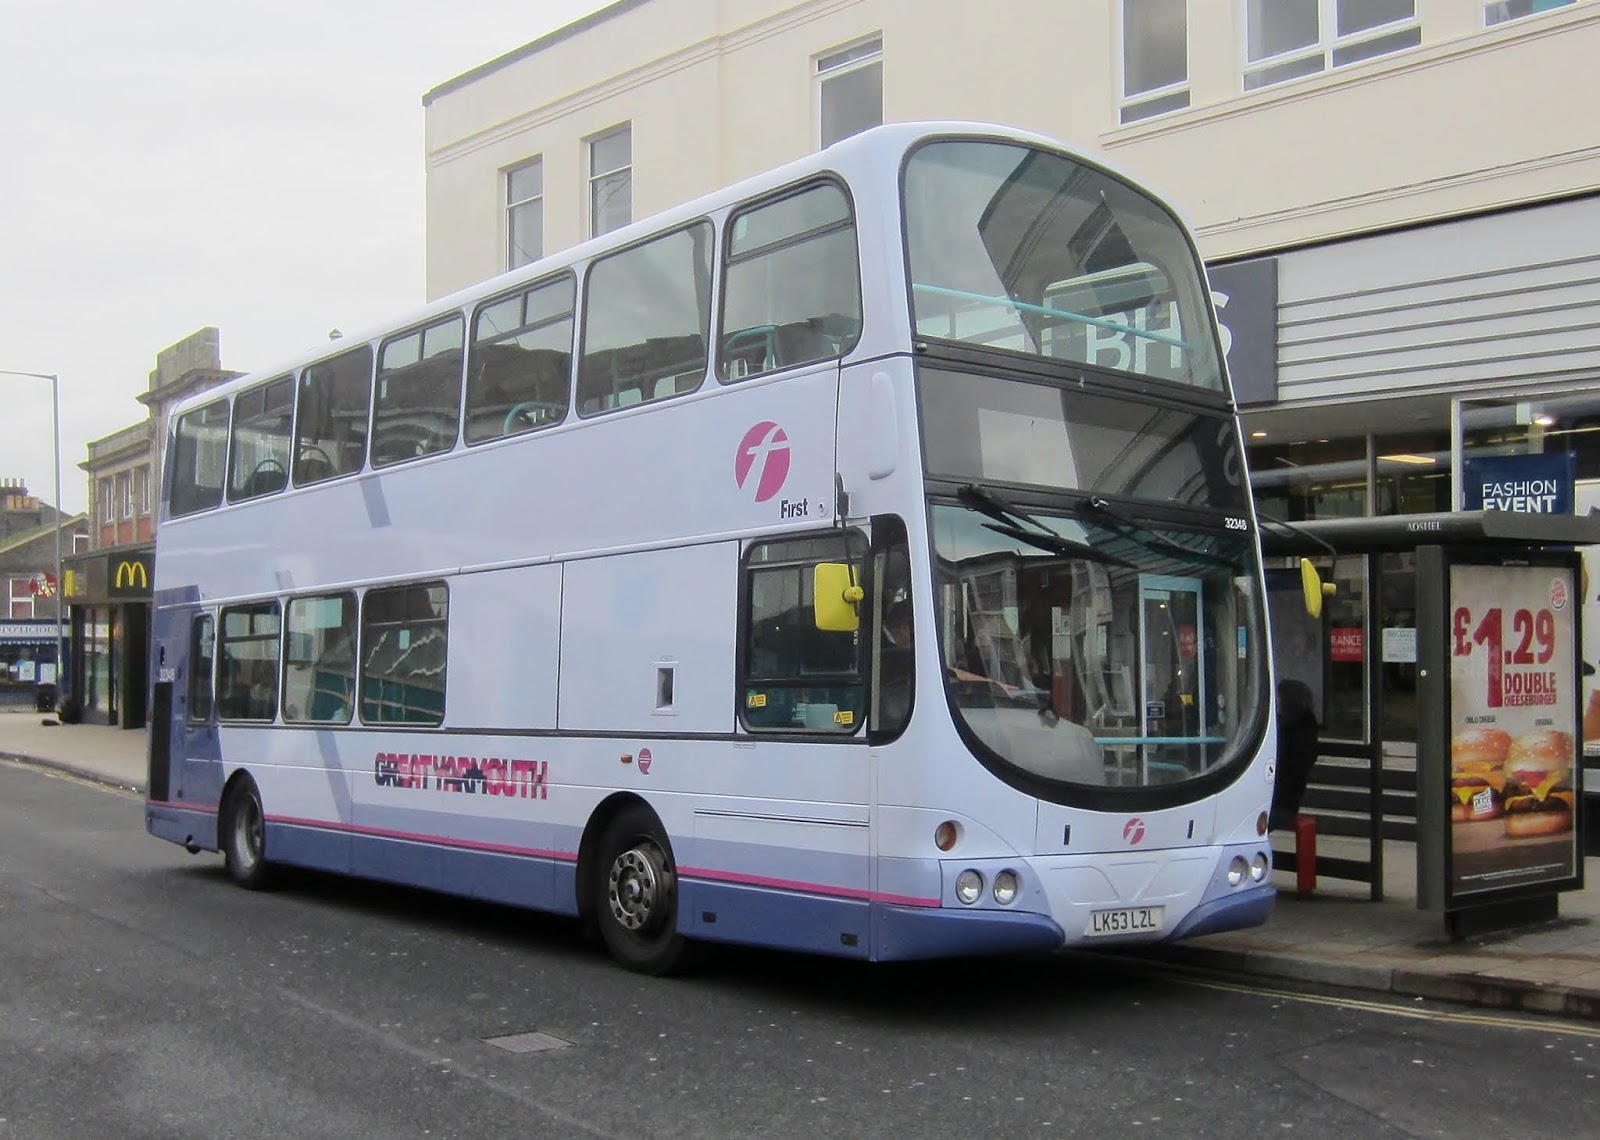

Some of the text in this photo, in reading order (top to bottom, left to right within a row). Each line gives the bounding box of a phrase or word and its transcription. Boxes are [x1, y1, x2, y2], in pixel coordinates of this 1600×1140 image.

[1482, 479, 1557, 498] FASHION
[780, 497, 808, 519] First
[1483, 495, 1557, 513] EVENT
[1224, 517, 1248, 531] 32348
[1407, 520, 1442, 532] ADSHEL
[1452, 606, 1556, 708] £1.29
[1504, 672, 1556, 694] DOUBLE
[1504, 693, 1557, 707] CHEESEBURGER
[374, 752, 549, 800] GREAT YARMOUTH
[1093, 910, 1156, 932] LK53 LZL
